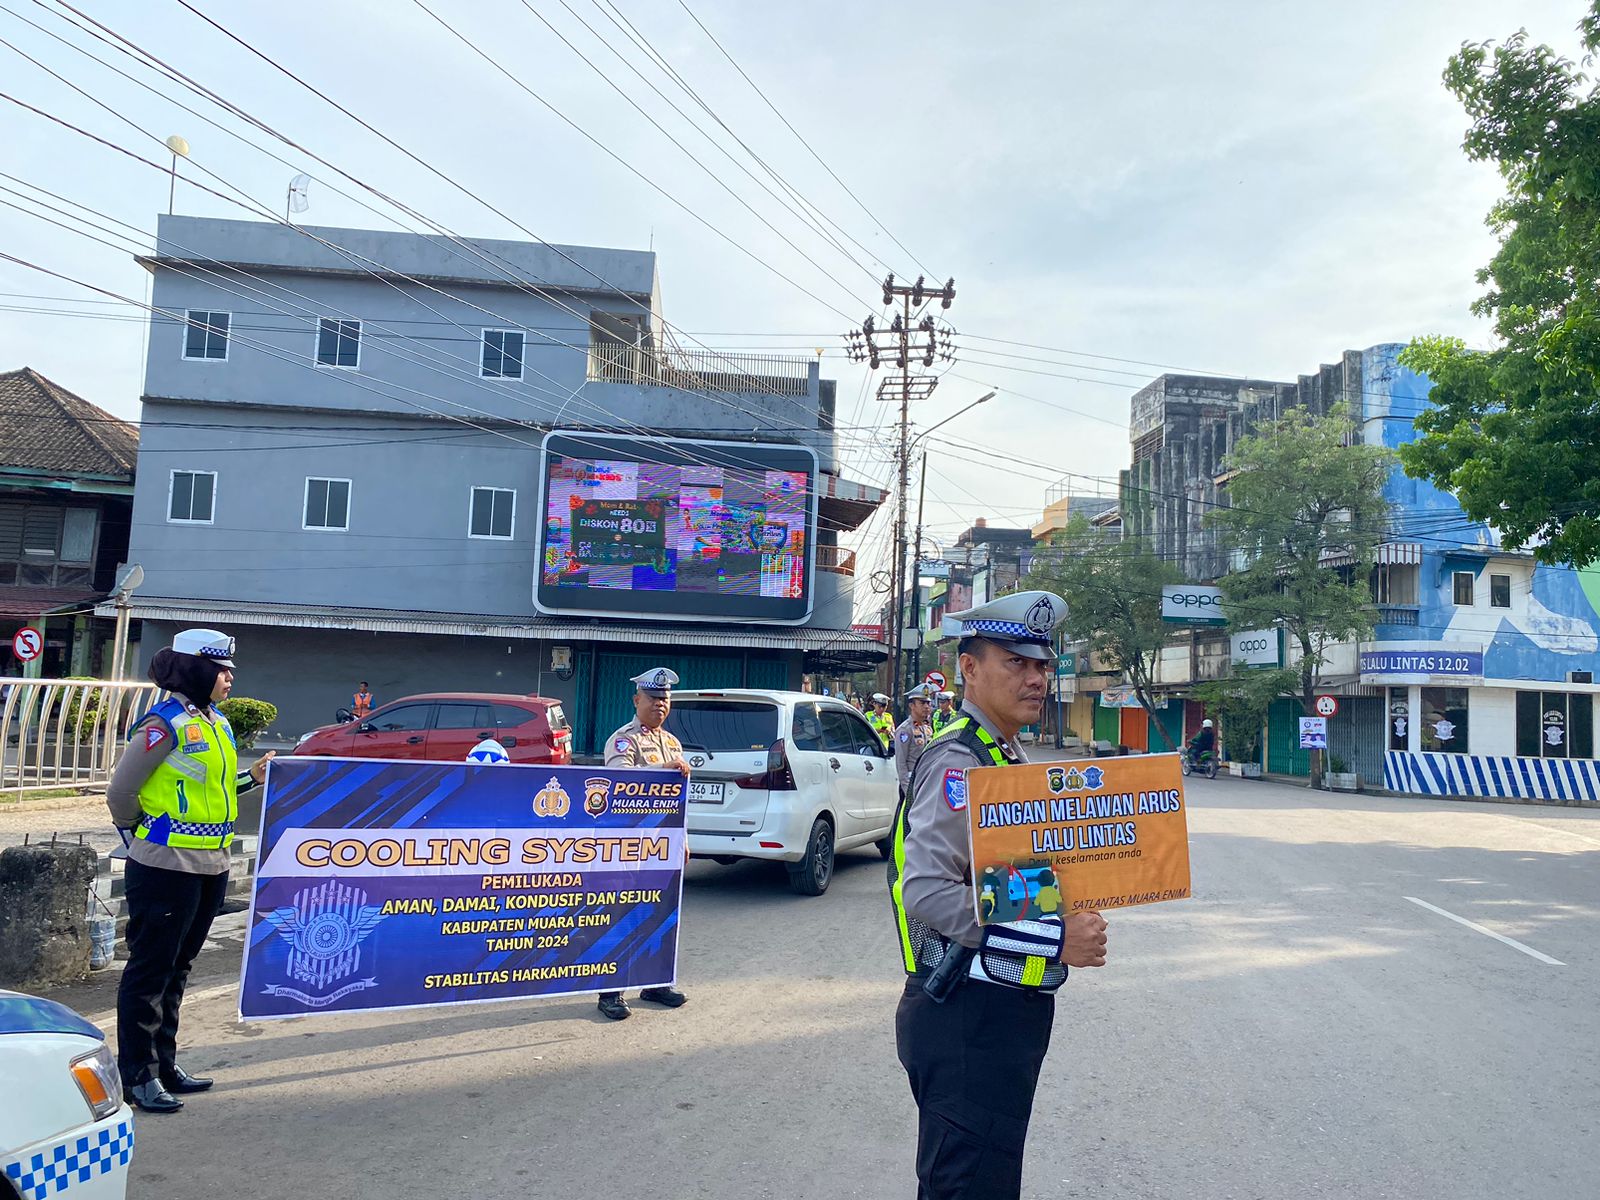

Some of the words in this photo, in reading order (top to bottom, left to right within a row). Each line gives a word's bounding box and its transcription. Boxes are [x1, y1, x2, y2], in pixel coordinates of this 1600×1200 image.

[580, 518, 618, 530] DISKON
[1240, 638, 1267, 654] oppo
[1367, 657, 1388, 670] LALU
[1390, 657, 1435, 670] LINTAS
[1438, 658, 1469, 671] 12.02
[613, 782, 682, 796] POLRES
[710, 785, 720, 795] IX
[612, 799, 650, 808] MUARA
[653, 800, 679, 808] ENIM
[978, 800, 1047, 828] JANGAN
[1050, 793, 1134, 822] MELAWAN
[1138, 789, 1180, 814] ARUS
[1032, 826, 1074, 853] LALU
[1078, 821, 1137, 849] LINTAS
[295, 838, 510, 868] COOLING
[522, 837, 669, 864] SYSTEM
[1055, 851, 1116, 865] keselamatan
[1118, 848, 1142, 859] anda
[482, 874, 583, 890] PEMILUKADA
[381, 898, 437, 915] AMAN,
[442, 897, 500, 913] DAMAI,
[505, 893, 584, 909] KONDUSIF
[587, 891, 617, 906] DAN
[619, 890, 661, 904] SEJUK
[1071, 895, 1126, 911] SATLANTAS
[1126, 891, 1160, 905] MUARA
[1161, 888, 1187, 901] ENIM
[442, 918, 525, 935] KABUPATEN
[528, 916, 575, 930] MUARA
[578, 914, 610, 928] ENIM
[486, 937, 535, 952] TAHUN
[538, 936, 569, 950] 2024
[424, 970, 509, 989] STABILITAS
[512, 962, 617, 983] HARKAMTIBMAS
